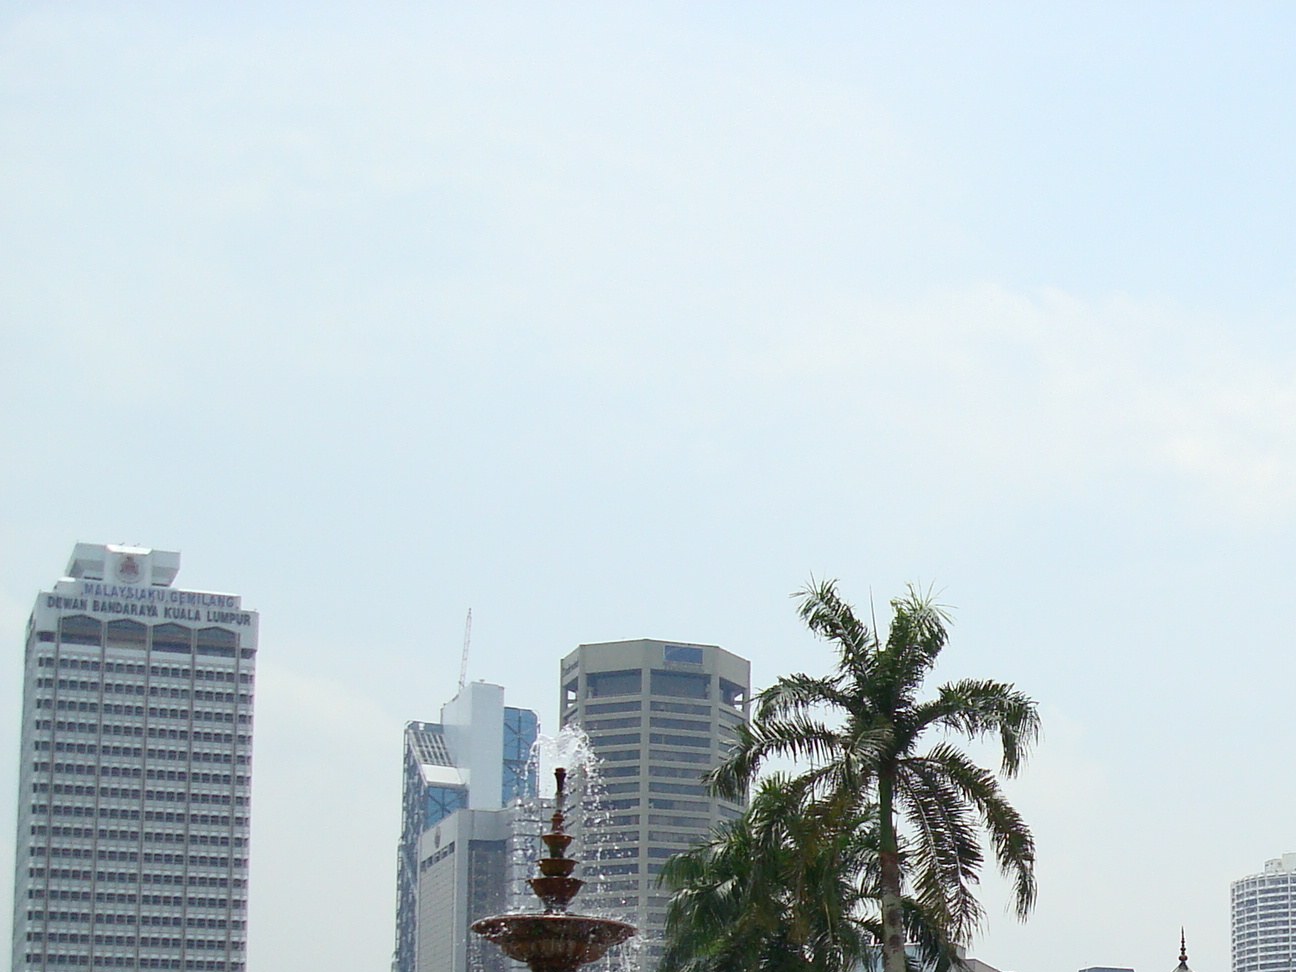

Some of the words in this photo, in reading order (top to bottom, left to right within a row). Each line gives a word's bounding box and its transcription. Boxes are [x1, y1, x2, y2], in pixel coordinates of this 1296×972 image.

[47, 596, 87, 611] DEWAN
[92, 600, 158, 617] BANDARAYA
[164, 606, 201, 621] KUALA
[206, 611, 251, 627] LUMPUR
